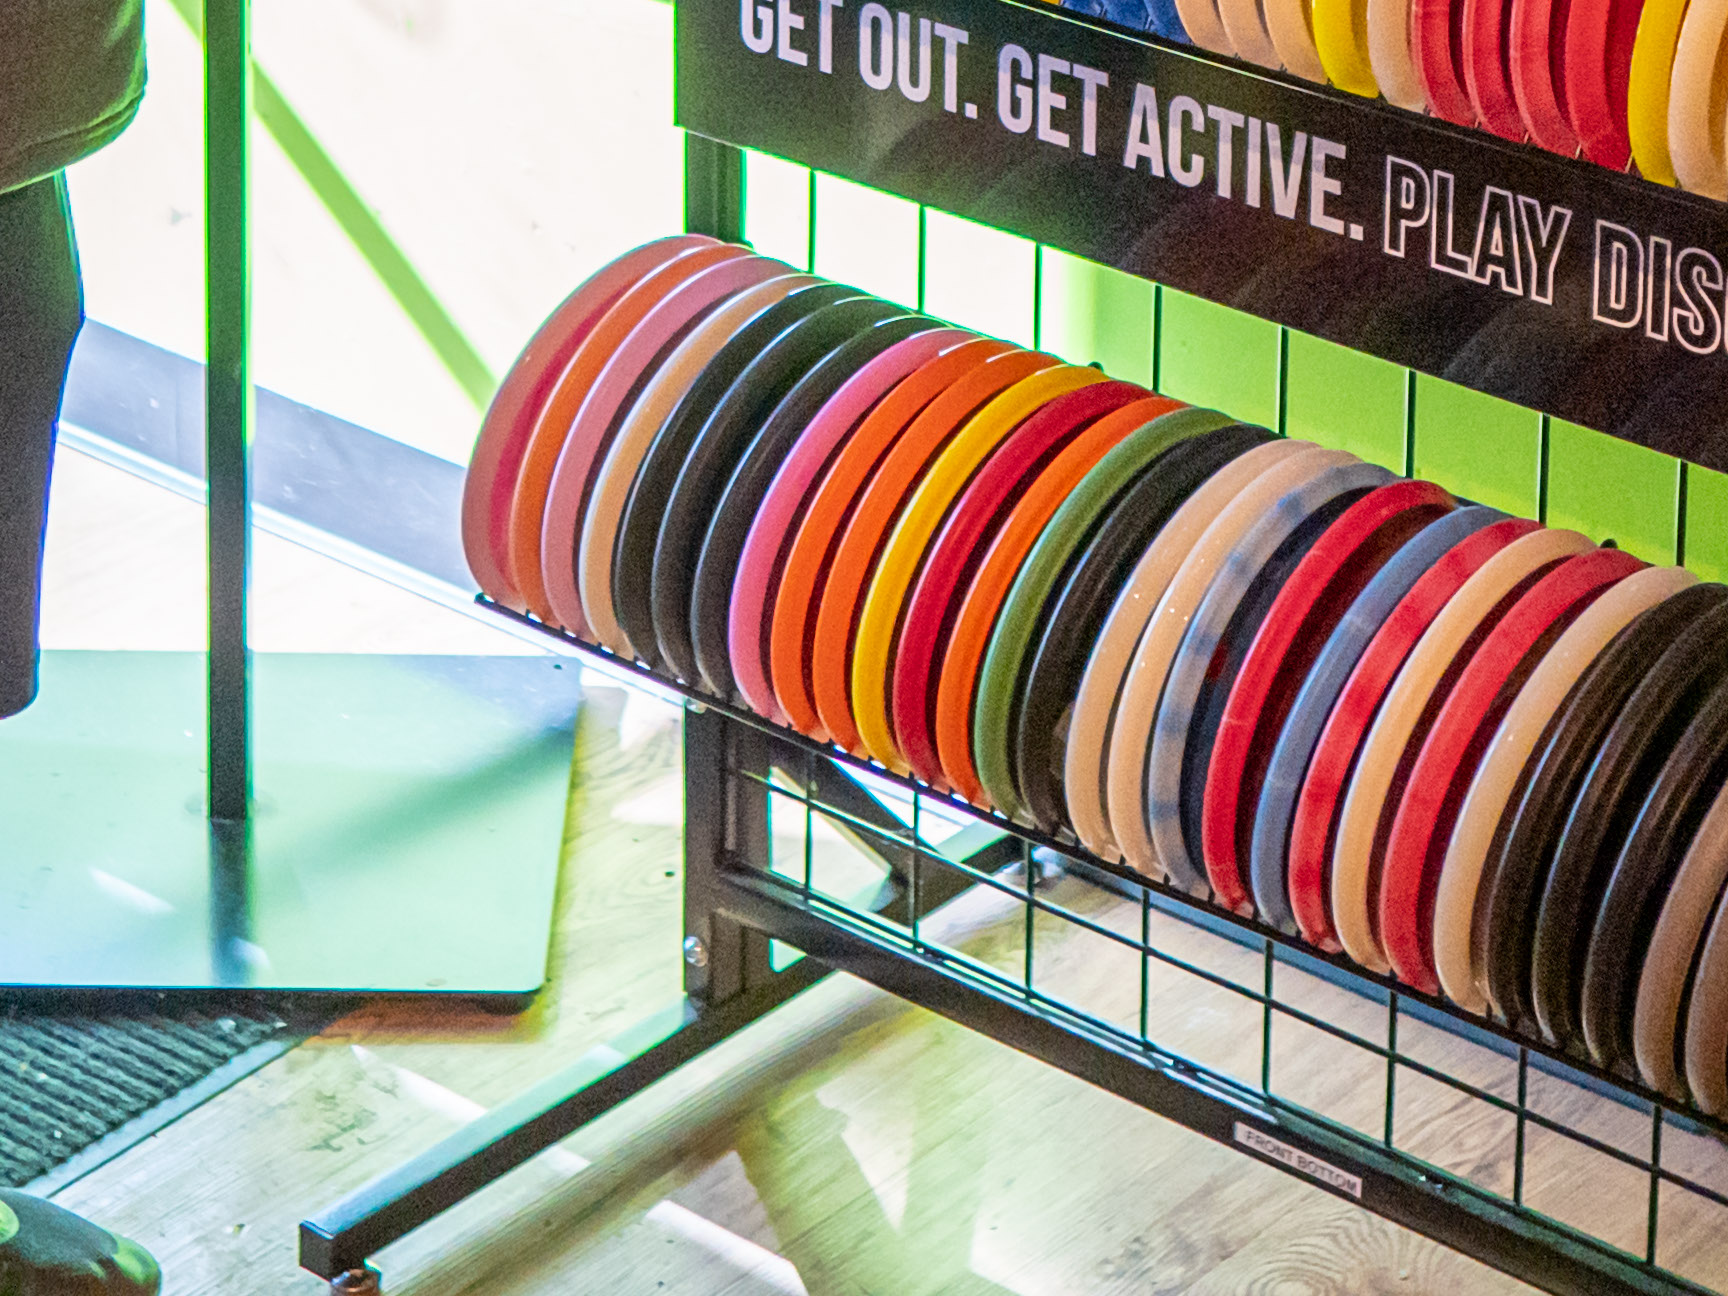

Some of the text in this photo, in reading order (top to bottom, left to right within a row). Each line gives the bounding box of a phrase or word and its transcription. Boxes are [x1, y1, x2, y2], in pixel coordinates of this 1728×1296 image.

[857, 2, 979, 120] OUT.
[996, 44, 1110, 158] GET
[1122, 82, 1365, 241] ACTIVE.
[1382, 154, 1573, 306] PLAY
[1245, 1130, 1357, 1194] FRONT BOTTOM
